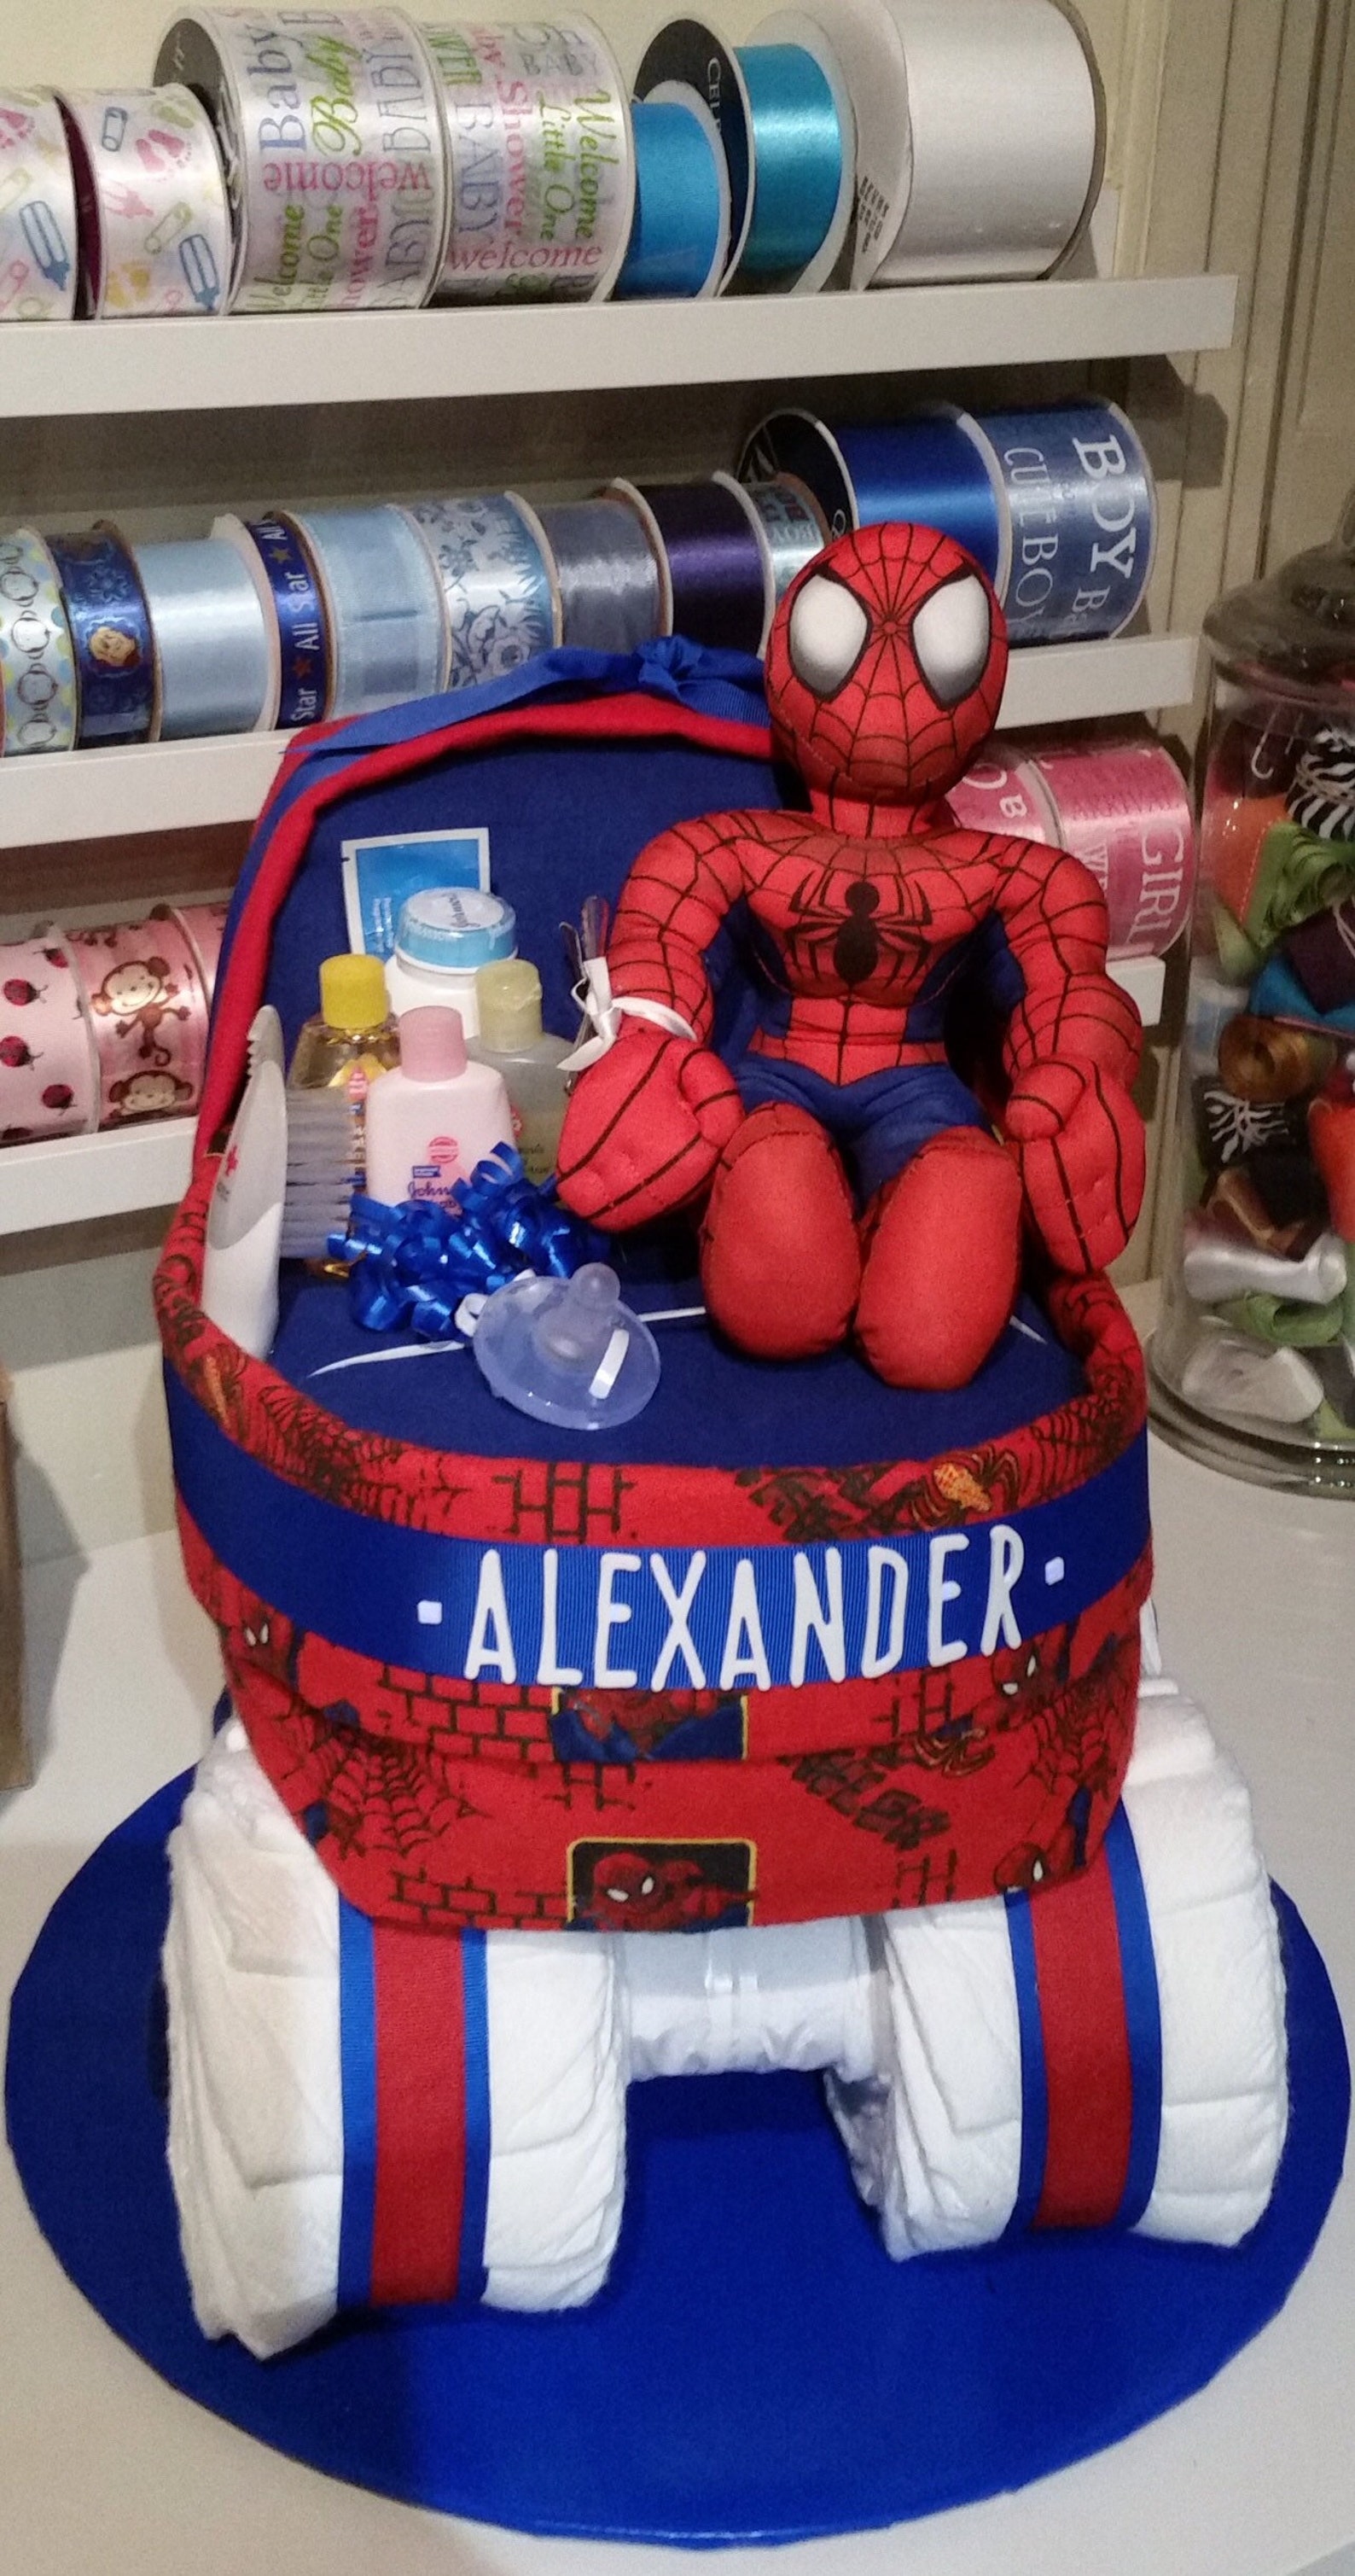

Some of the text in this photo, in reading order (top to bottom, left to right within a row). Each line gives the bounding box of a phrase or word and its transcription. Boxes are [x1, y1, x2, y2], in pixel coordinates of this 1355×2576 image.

[245, 24, 307, 152] Baby
[305, 34, 363, 156] Baby
[363, 48, 431, 153] BABY
[263, 161, 435, 202] welcome
[454, 102, 502, 233] BABY
[495, 80, 534, 235] Shower
[539, 183, 576, 242] One
[573, 89, 620, 240] Welcome
[449, 241, 603, 272] welcome
[1072, 434, 1137, 580] BOY
[284, 571, 321, 651] All Star
[292, 687, 318, 723] Star
[462, 1524, 1025, 1693] ALEXANDER
